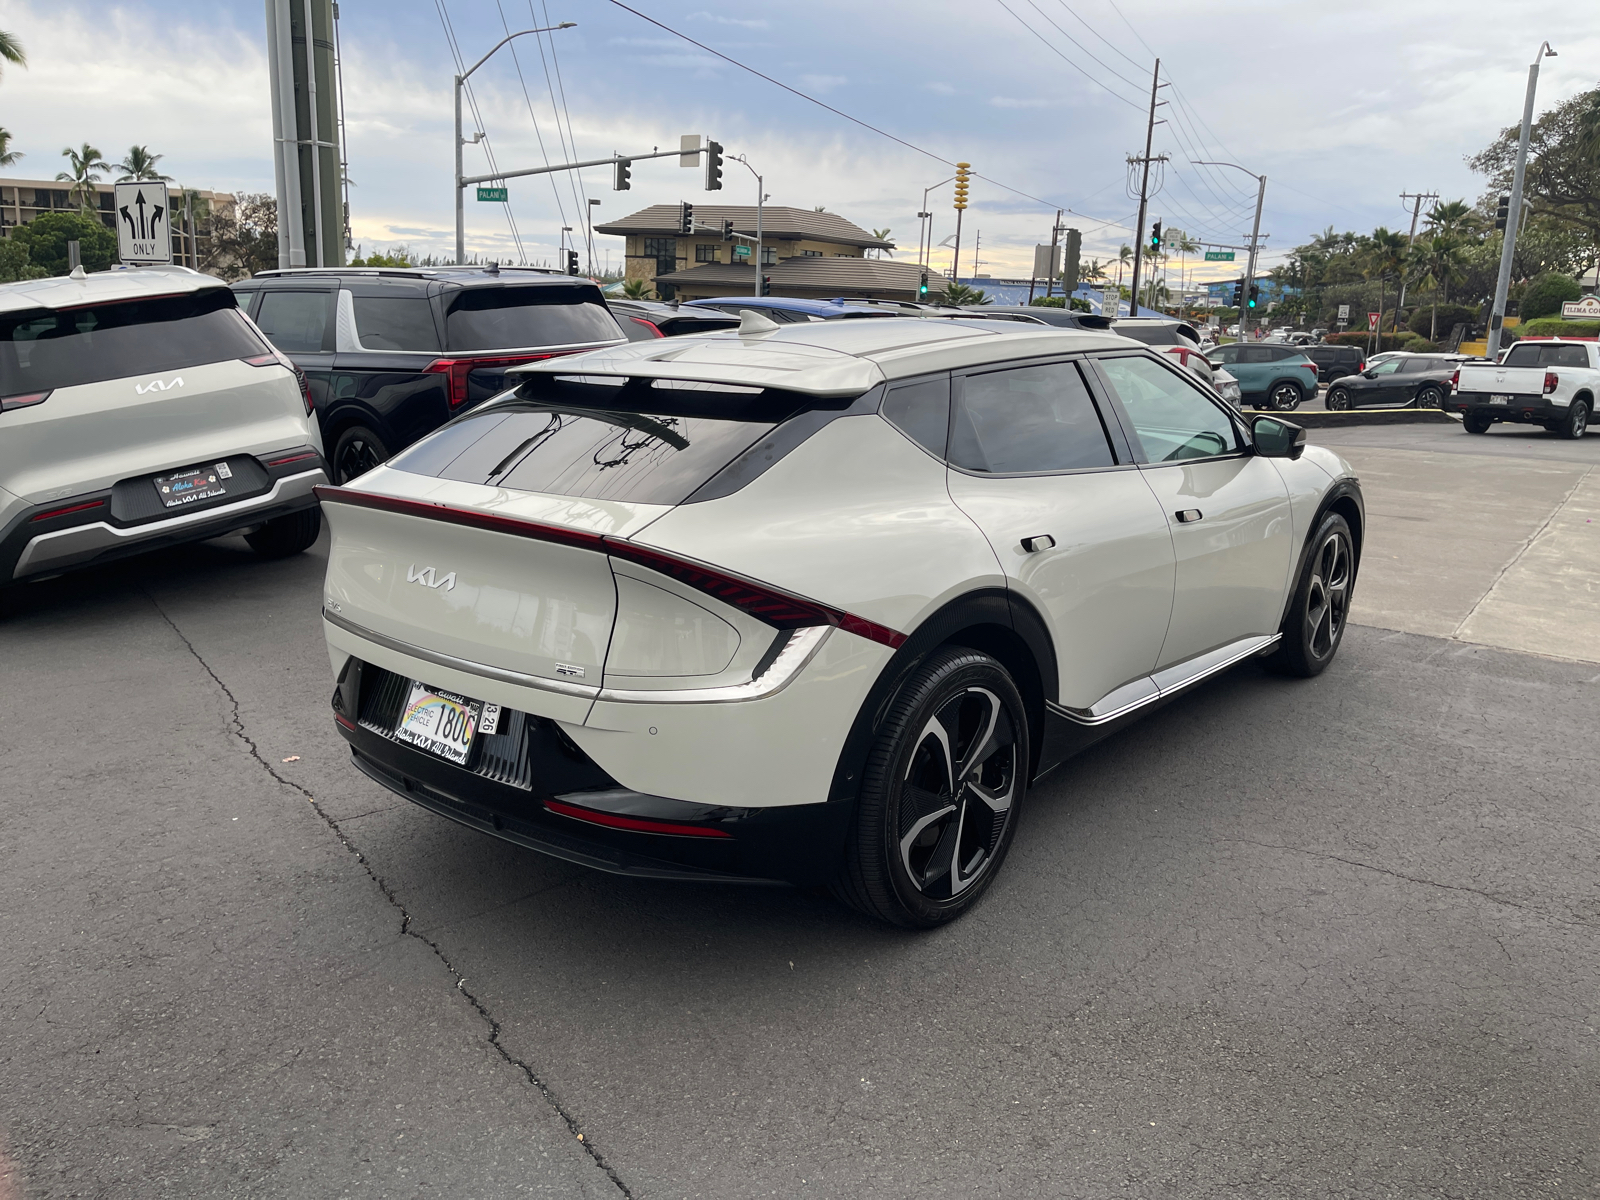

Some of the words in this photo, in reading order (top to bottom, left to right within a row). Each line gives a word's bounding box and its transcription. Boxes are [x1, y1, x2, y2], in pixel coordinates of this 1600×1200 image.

[479, 190, 499, 199] PALANI
[133, 243, 156, 256] ONLY
[1105, 306, 1115, 314] RED
[135, 376, 185, 395] KIA
[172, 480, 193, 492] Aloha
[194, 478, 207, 487] Kia
[182, 494, 197, 503] KIA
[198, 490, 207, 499] All
[207, 487, 226, 497] Islands
[406, 563, 457, 592] KIA
[407, 703, 434, 718] ELECTRIC
[407, 712, 431, 727] VEHICLE
[483, 717, 495, 731] 26
[394, 727, 412, 742] Aloha
[413, 735, 431, 750] KIA
[431, 741, 444, 754] All
[442, 745, 466, 765] Islands
